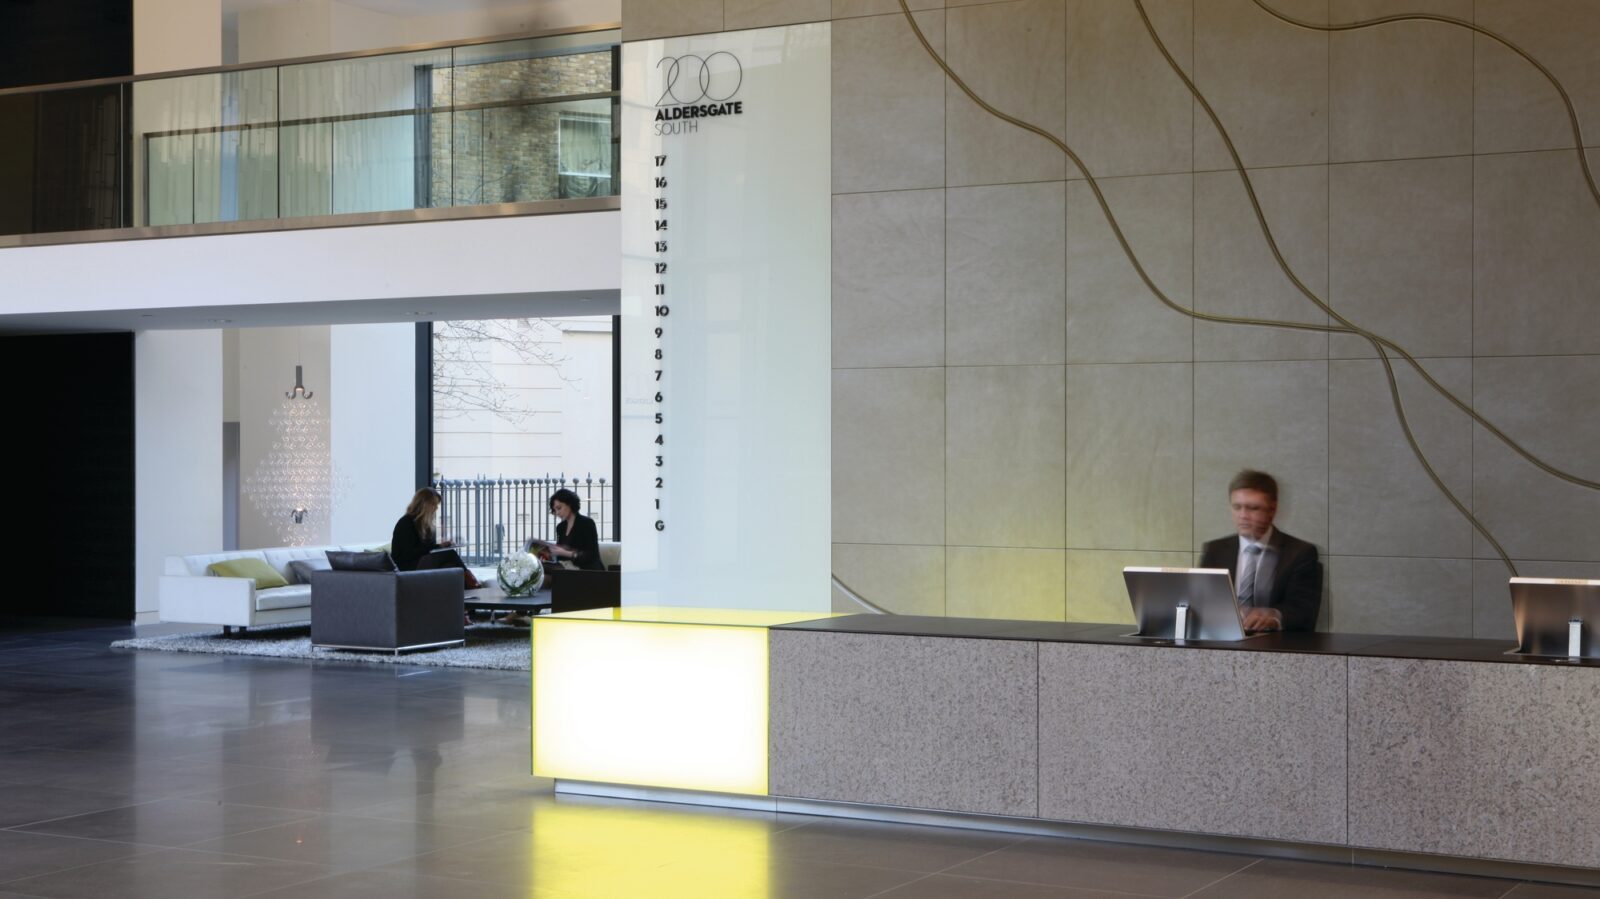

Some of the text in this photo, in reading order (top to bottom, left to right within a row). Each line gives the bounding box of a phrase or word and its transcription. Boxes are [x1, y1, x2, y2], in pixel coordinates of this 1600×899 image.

[655, 51, 742, 106] 200
[655, 101, 743, 121] ALDERSGATE
[654, 120, 698, 136] SOUTH
[655, 155, 667, 167] 17
[655, 177, 668, 189] 16
[655, 199, 668, 210] 15
[655, 220, 668, 232] 14
[655, 241, 668, 253] 13
[655, 262, 668, 274] 12
[655, 284, 665, 296] 11
[655, 305, 670, 317] 10
[655, 327, 664, 339] 9
[655, 349, 663, 361] 8
[655, 370, 663, 382] 7
[655, 392, 664, 404] 6
[655, 413, 664, 425] 5
[655, 434, 664, 446] 4
[655, 456, 664, 468] 3
[655, 477, 664, 489] 2
[655, 499, 660, 510] 1
[655, 520, 665, 532] G
